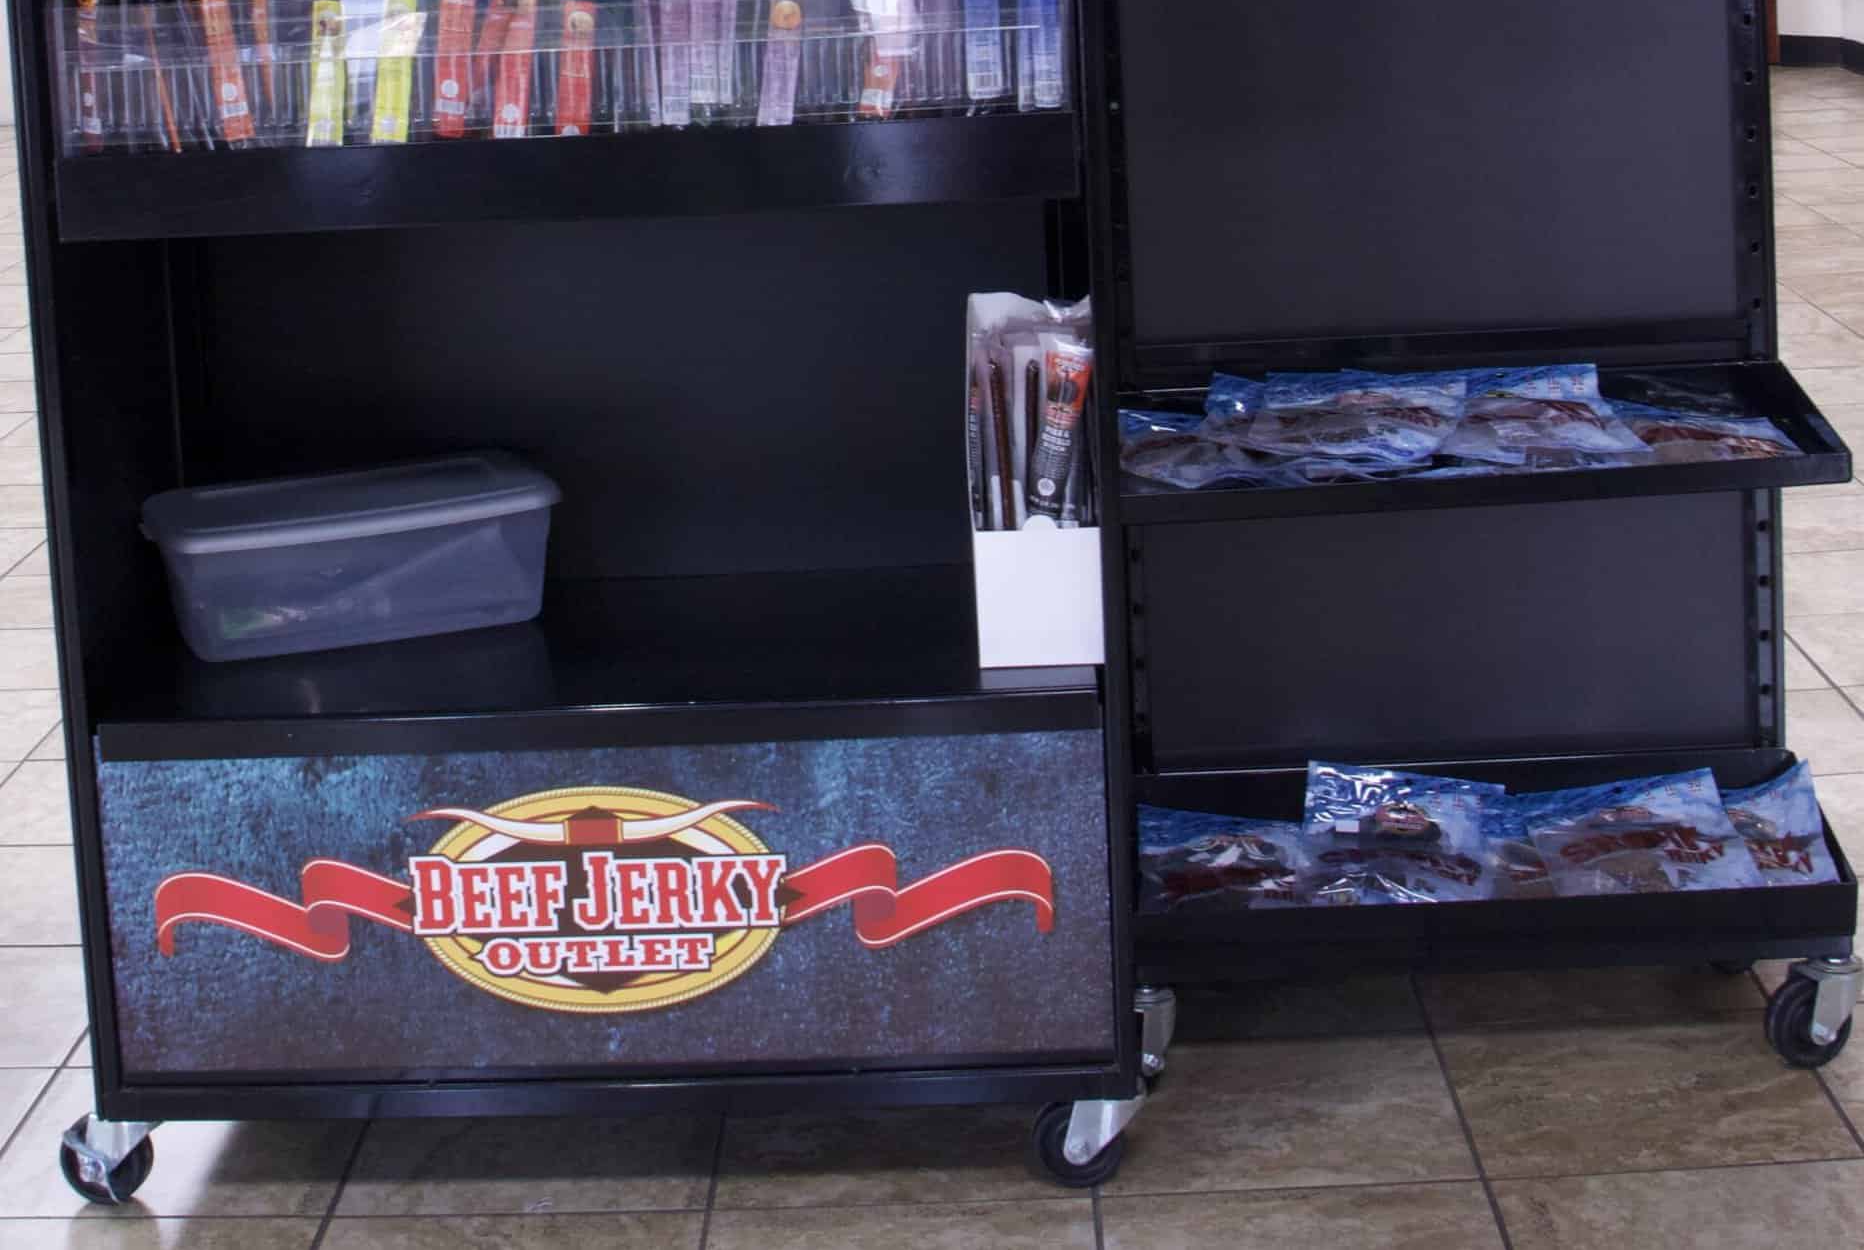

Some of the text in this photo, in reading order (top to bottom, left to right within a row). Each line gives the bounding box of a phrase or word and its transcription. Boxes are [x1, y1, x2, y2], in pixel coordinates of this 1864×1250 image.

[409, 850, 786, 935] BEEF JERKY
[477, 934, 715, 975] OUTLET
